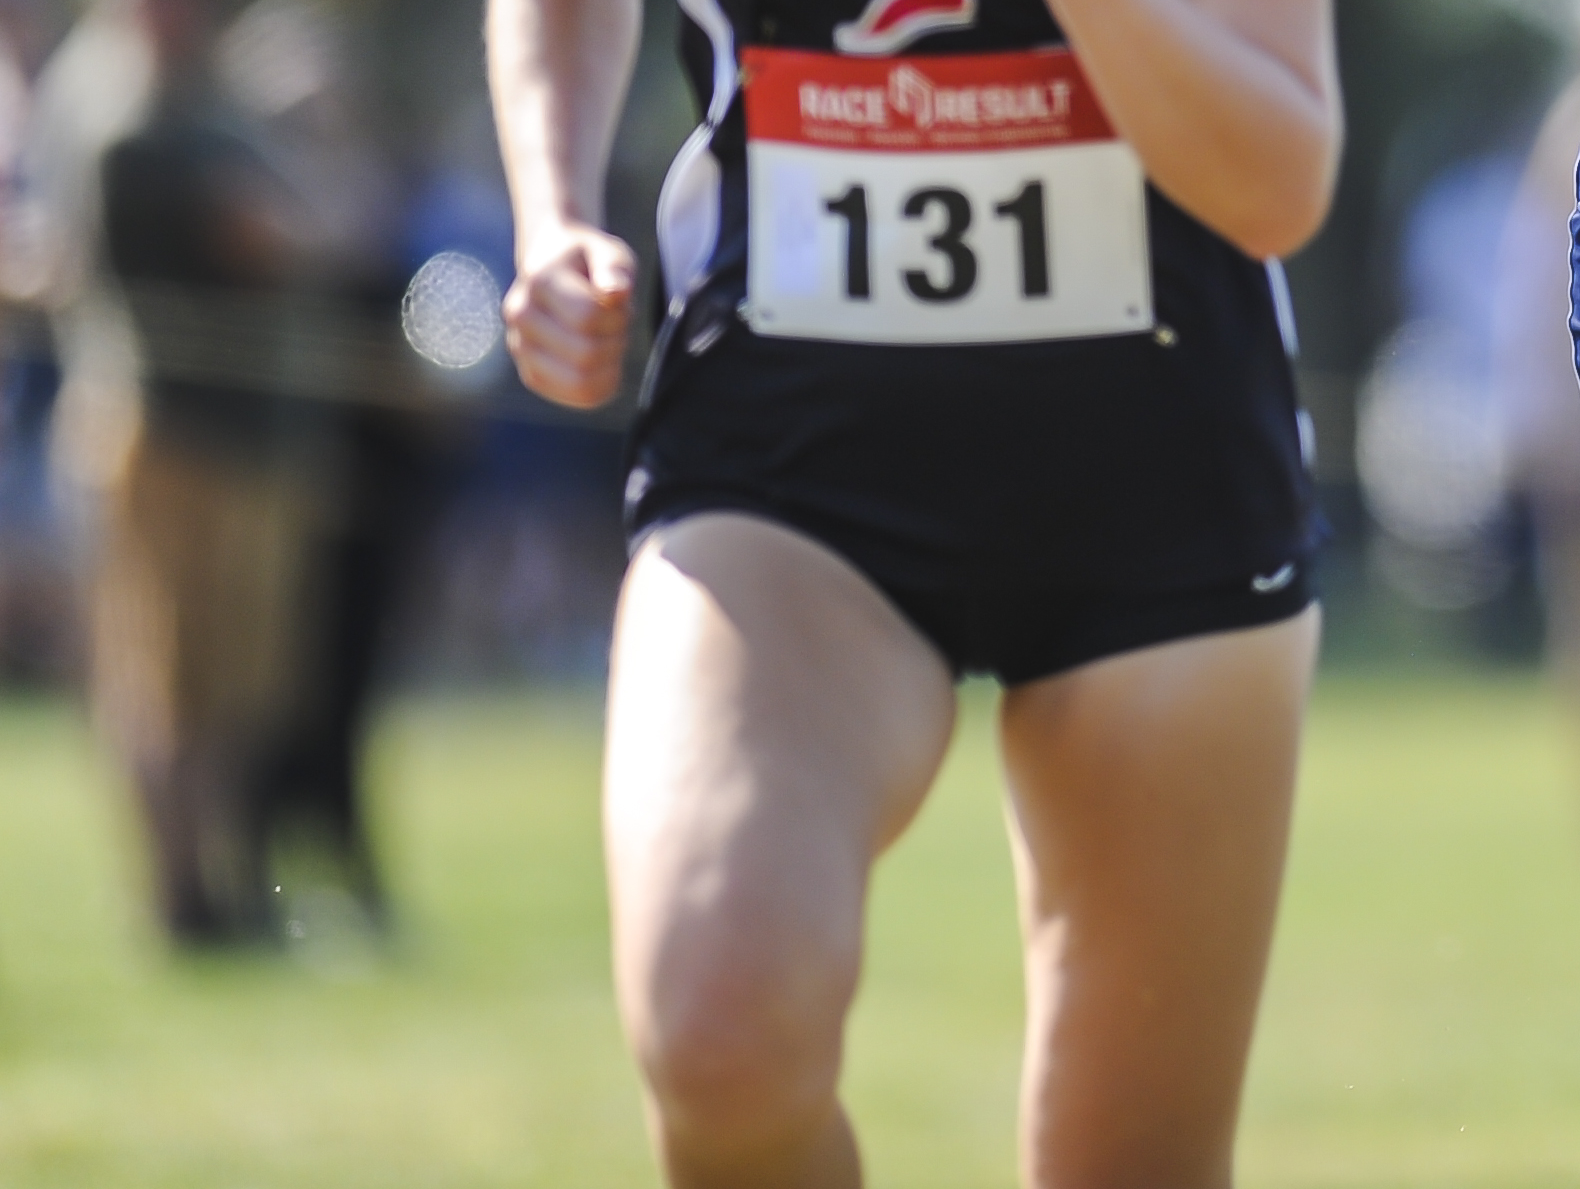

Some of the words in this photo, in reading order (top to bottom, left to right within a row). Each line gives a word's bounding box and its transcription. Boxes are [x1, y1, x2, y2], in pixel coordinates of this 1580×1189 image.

[799, 81, 885, 126] RACE
[934, 79, 1070, 125] RESULT
[824, 179, 1052, 303] 131
